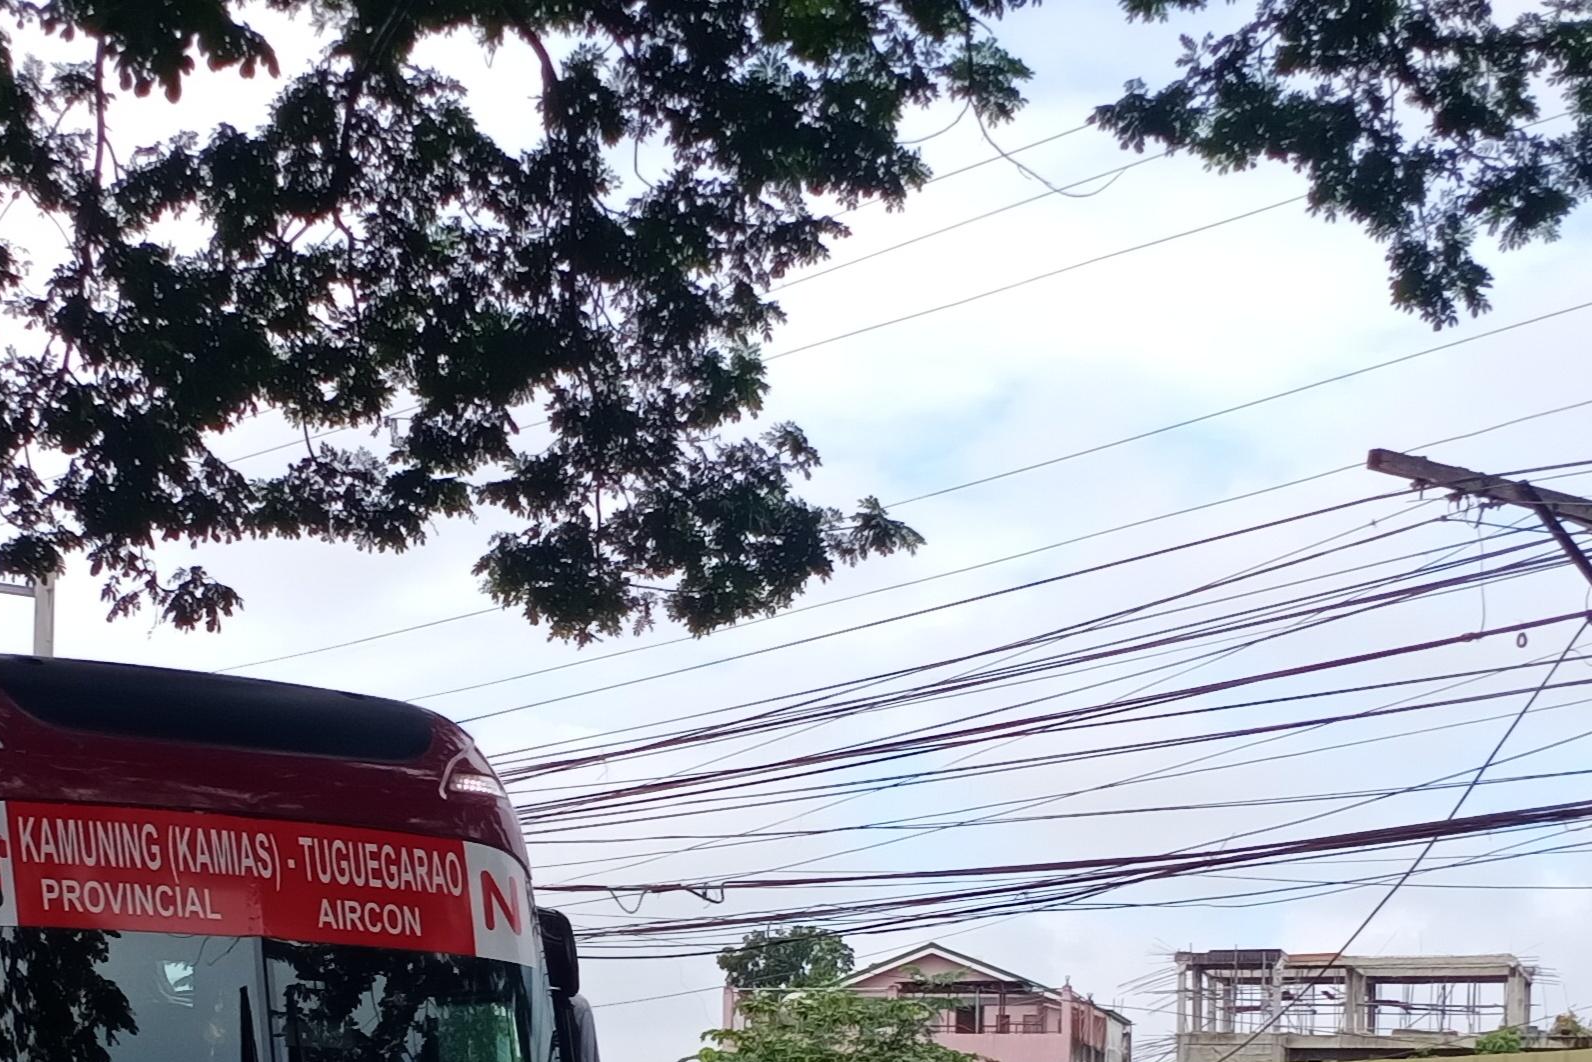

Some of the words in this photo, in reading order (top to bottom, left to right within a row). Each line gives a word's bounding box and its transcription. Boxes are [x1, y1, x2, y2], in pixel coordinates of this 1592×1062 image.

[18, 816, 160, 870] KAMUNING
[168, 825, 281, 892] (KAMIAS)
[298, 836, 463, 896] TUGUEGARAO
[41, 878, 222, 920] PROVINCIAL
[319, 898, 422, 937] AIRCON
